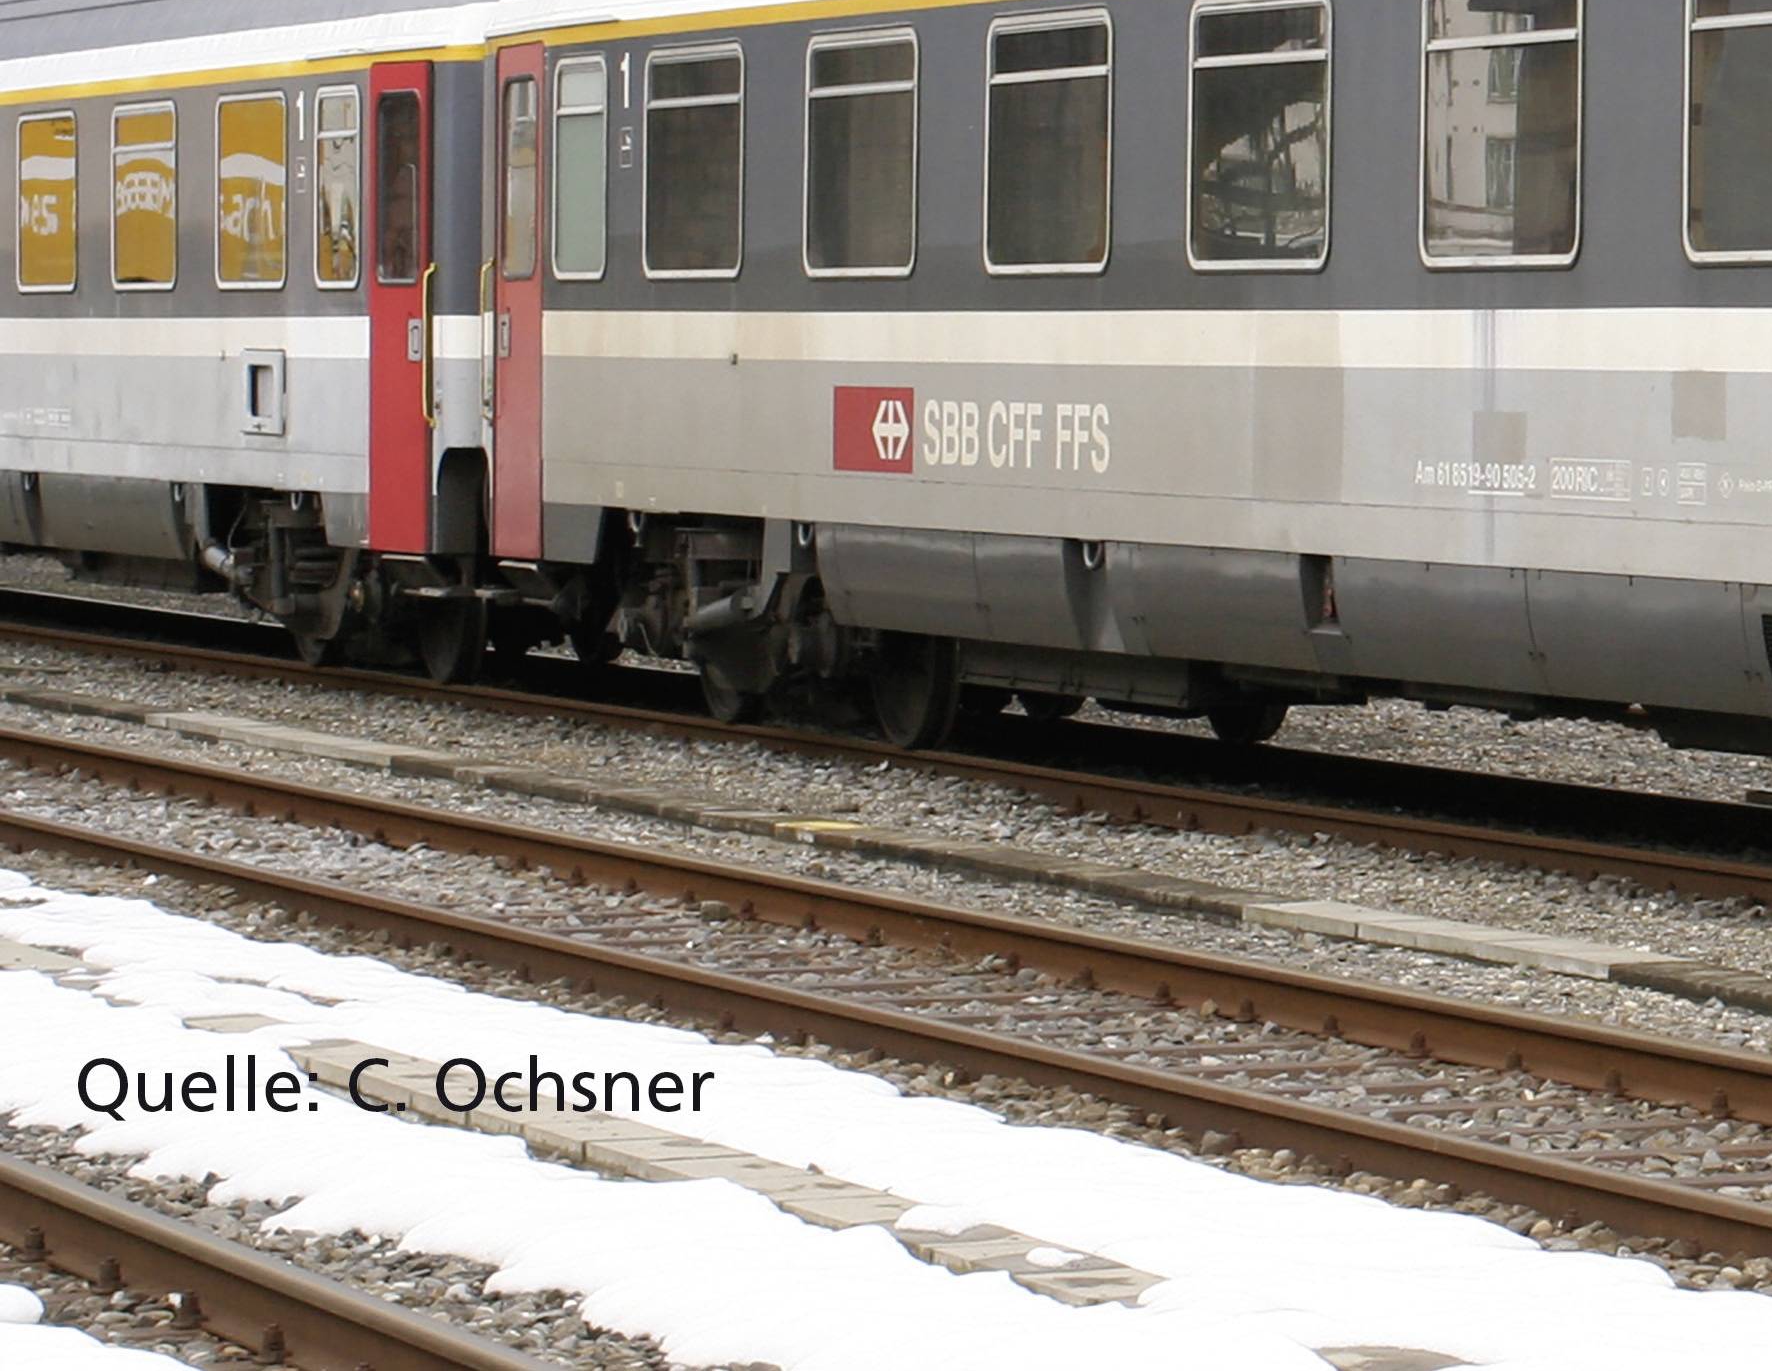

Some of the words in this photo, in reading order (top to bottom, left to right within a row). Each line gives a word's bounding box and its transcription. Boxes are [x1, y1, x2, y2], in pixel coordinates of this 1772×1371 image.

[619, 51, 631, 110] 1
[296, 89, 305, 142] 1
[922, 398, 981, 467] SBB
[987, 399, 1043, 470] CFF
[1055, 402, 1111, 475] FFS
